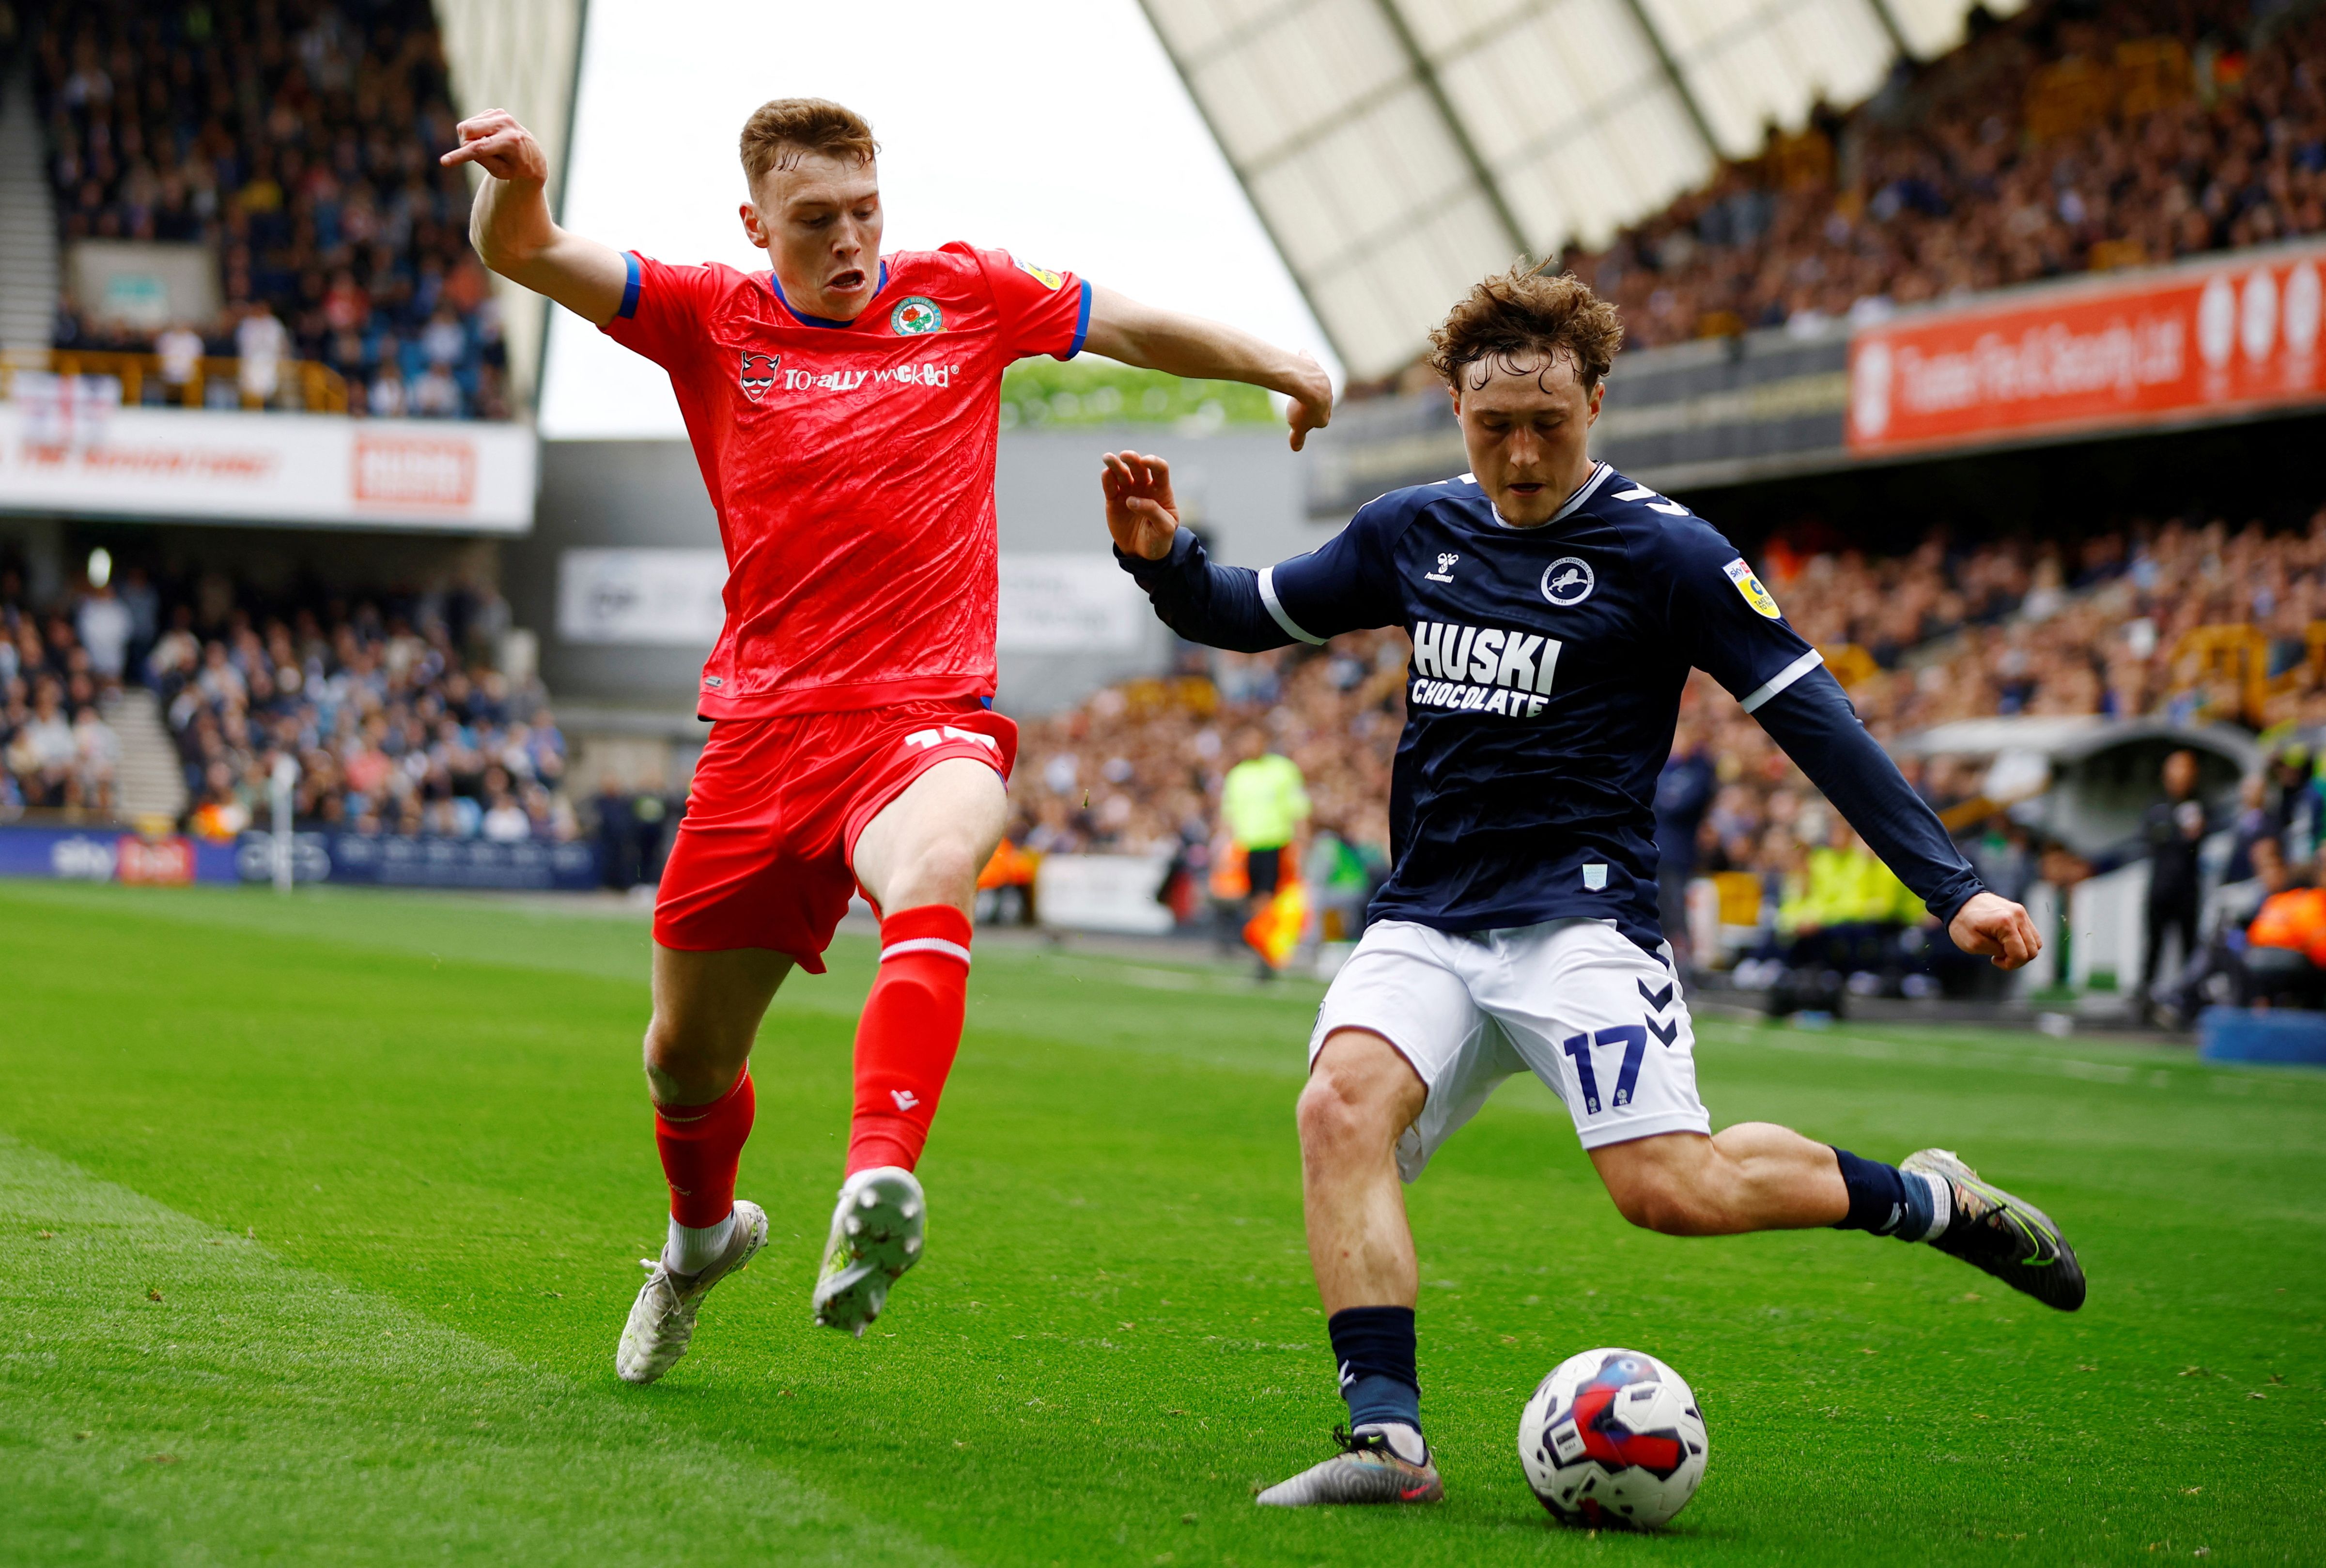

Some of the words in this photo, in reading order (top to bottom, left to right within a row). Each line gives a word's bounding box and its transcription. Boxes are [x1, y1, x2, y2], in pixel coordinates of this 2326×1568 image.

[892, 299, 909, 334] BLACKBURN
[911, 297, 938, 310] ROVERS
[1424, 571, 1454, 584] hummel
[1544, 559, 1565, 577] MILLWALL
[1566, 558, 1589, 572] FOOTBALL
[1730, 566, 1744, 578] sky
[1413, 621, 1563, 695] HUSKI
[1411, 678, 1549, 718] CHOCOLATE
[1563, 1024, 1647, 1115] 17
